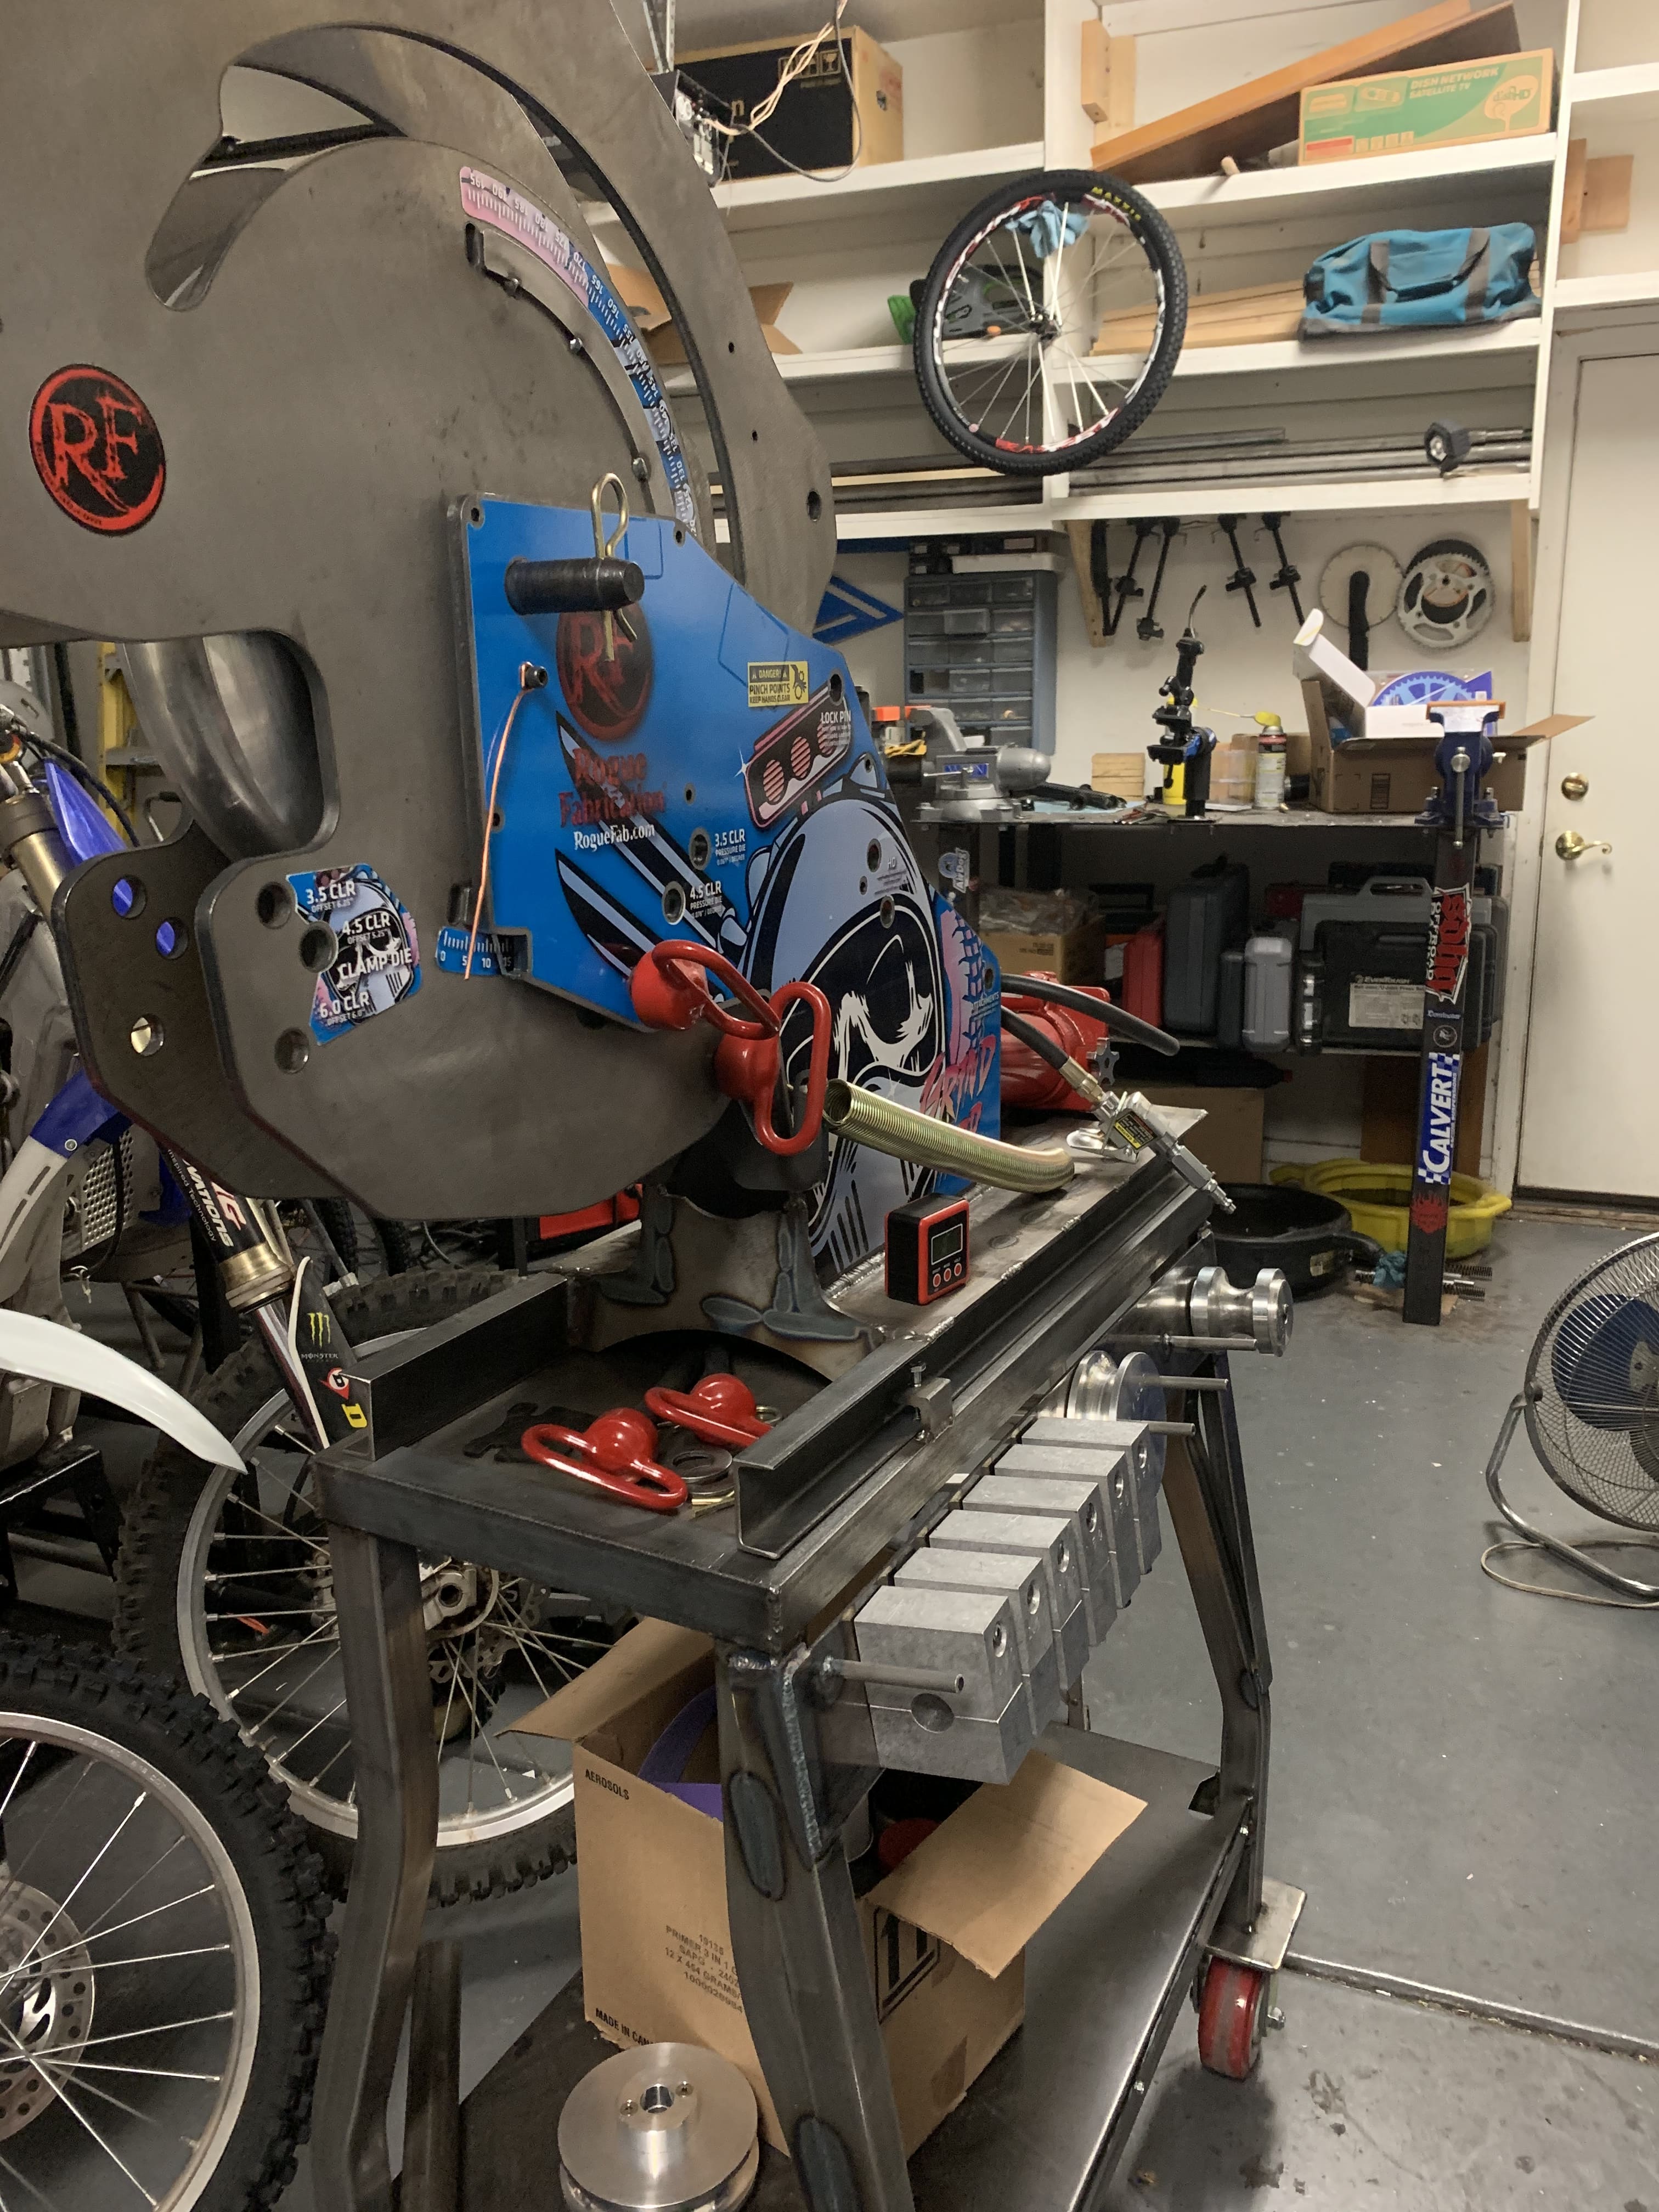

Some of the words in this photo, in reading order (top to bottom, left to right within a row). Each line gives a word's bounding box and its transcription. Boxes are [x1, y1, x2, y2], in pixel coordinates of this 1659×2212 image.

[1441, 67, 1499, 84] NETWORK
[1091, 187, 1142, 221] MAXXIS
[591, 274, 603, 295] 165
[607, 298, 619, 319] 160
[759, 669, 781, 679] DANGER!
[749, 684, 768, 695] PINCH
[770, 683, 791, 693] POINTS
[821, 712, 838, 724] LOCK
[840, 710, 851, 723] PIN
[573, 748, 647, 786] Rogue
[558, 783, 665, 828] Fabrication
[573, 823, 655, 853] RogueFab.com
[714, 832, 727, 847] 3.5
[729, 828, 746, 844] CLR
[715, 845, 738, 857] PRESSURE
[305, 886, 327, 904] 3.5
[330, 880, 356, 900] CLR
[690, 884, 703, 900] 4.5
[705, 881, 722, 896] CLR
[311, 901, 336, 913] OFFSET
[690, 899, 714, 911] PRESSURE
[342, 918, 363, 936] 4.5
[365, 911, 391, 931] CLR
[347, 933, 370, 944] OFFSET
[337, 956, 387, 980] CLAMP
[391, 947, 413, 966] DIE
[440, 950, 446, 962] 0
[482, 957, 491, 968] 10
[319, 999, 341, 1018] 6.0
[343, 990, 370, 1011] CLR
[327, 1012, 351, 1026] OFFSET
[1423, 1062, 1452, 1173] CALVERT
[182, 1158, 234, 1247] VATIONS
[188, 1188, 217, 1242] Technology
[585, 1768, 630, 1800] AEROSOLS
[665, 1946, 674, 1959] 12
[676, 1955, 682, 1963] X
[666, 1925, 702, 1953] PRIMER
[704, 1948, 709, 1957] 3
[712, 1953, 721, 1966] IN
[724, 1961, 728, 1970] 1
[595, 2007, 619, 2031] MADE
[621, 2023, 630, 2038] IN
[632, 2031, 654, 2046] CAN
